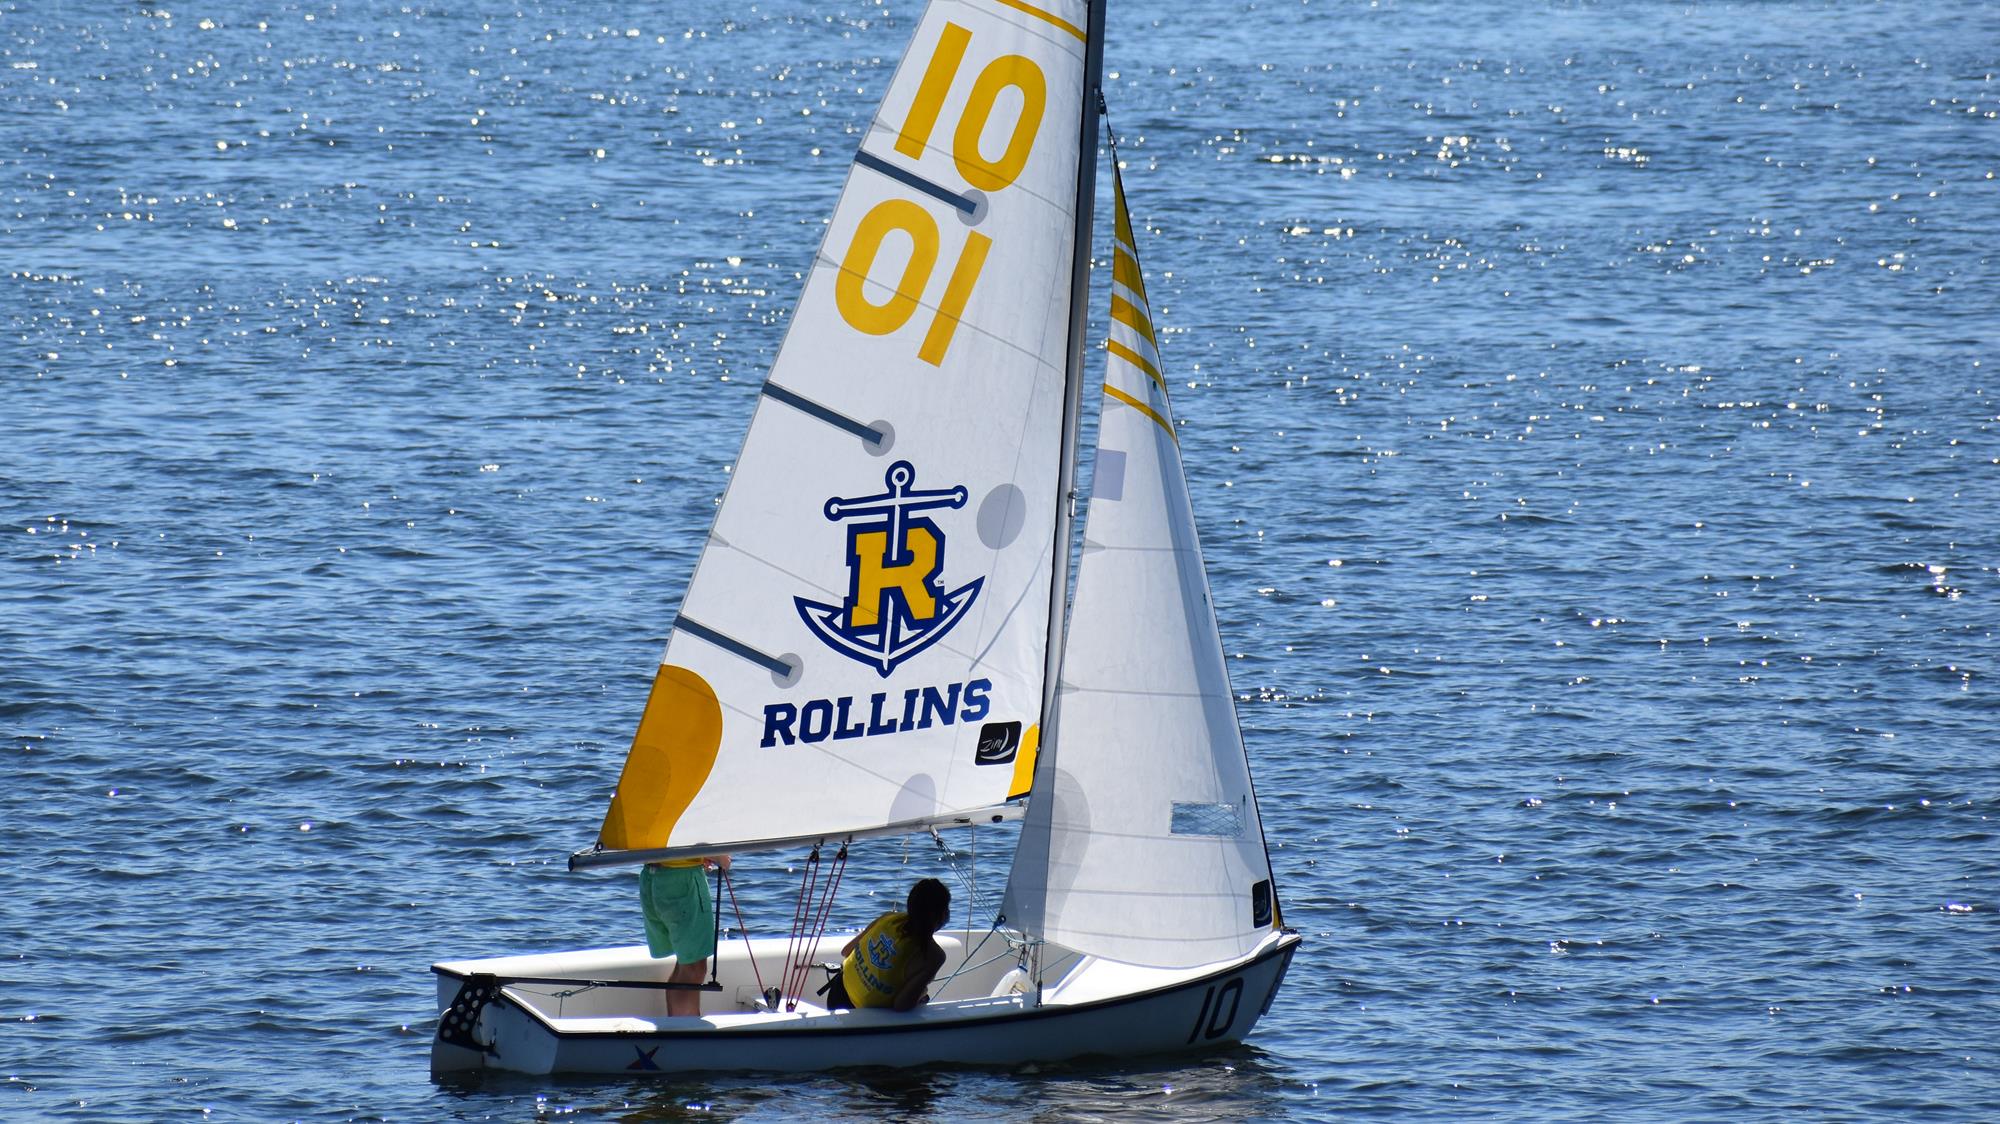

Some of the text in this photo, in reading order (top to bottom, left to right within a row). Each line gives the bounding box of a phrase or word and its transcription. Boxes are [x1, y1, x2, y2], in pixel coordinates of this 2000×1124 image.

[894, 21, 1047, 192] 10
[845, 516, 946, 630] R
[760, 678, 993, 748] ROLLINS
[1187, 976, 1244, 1045] 10
